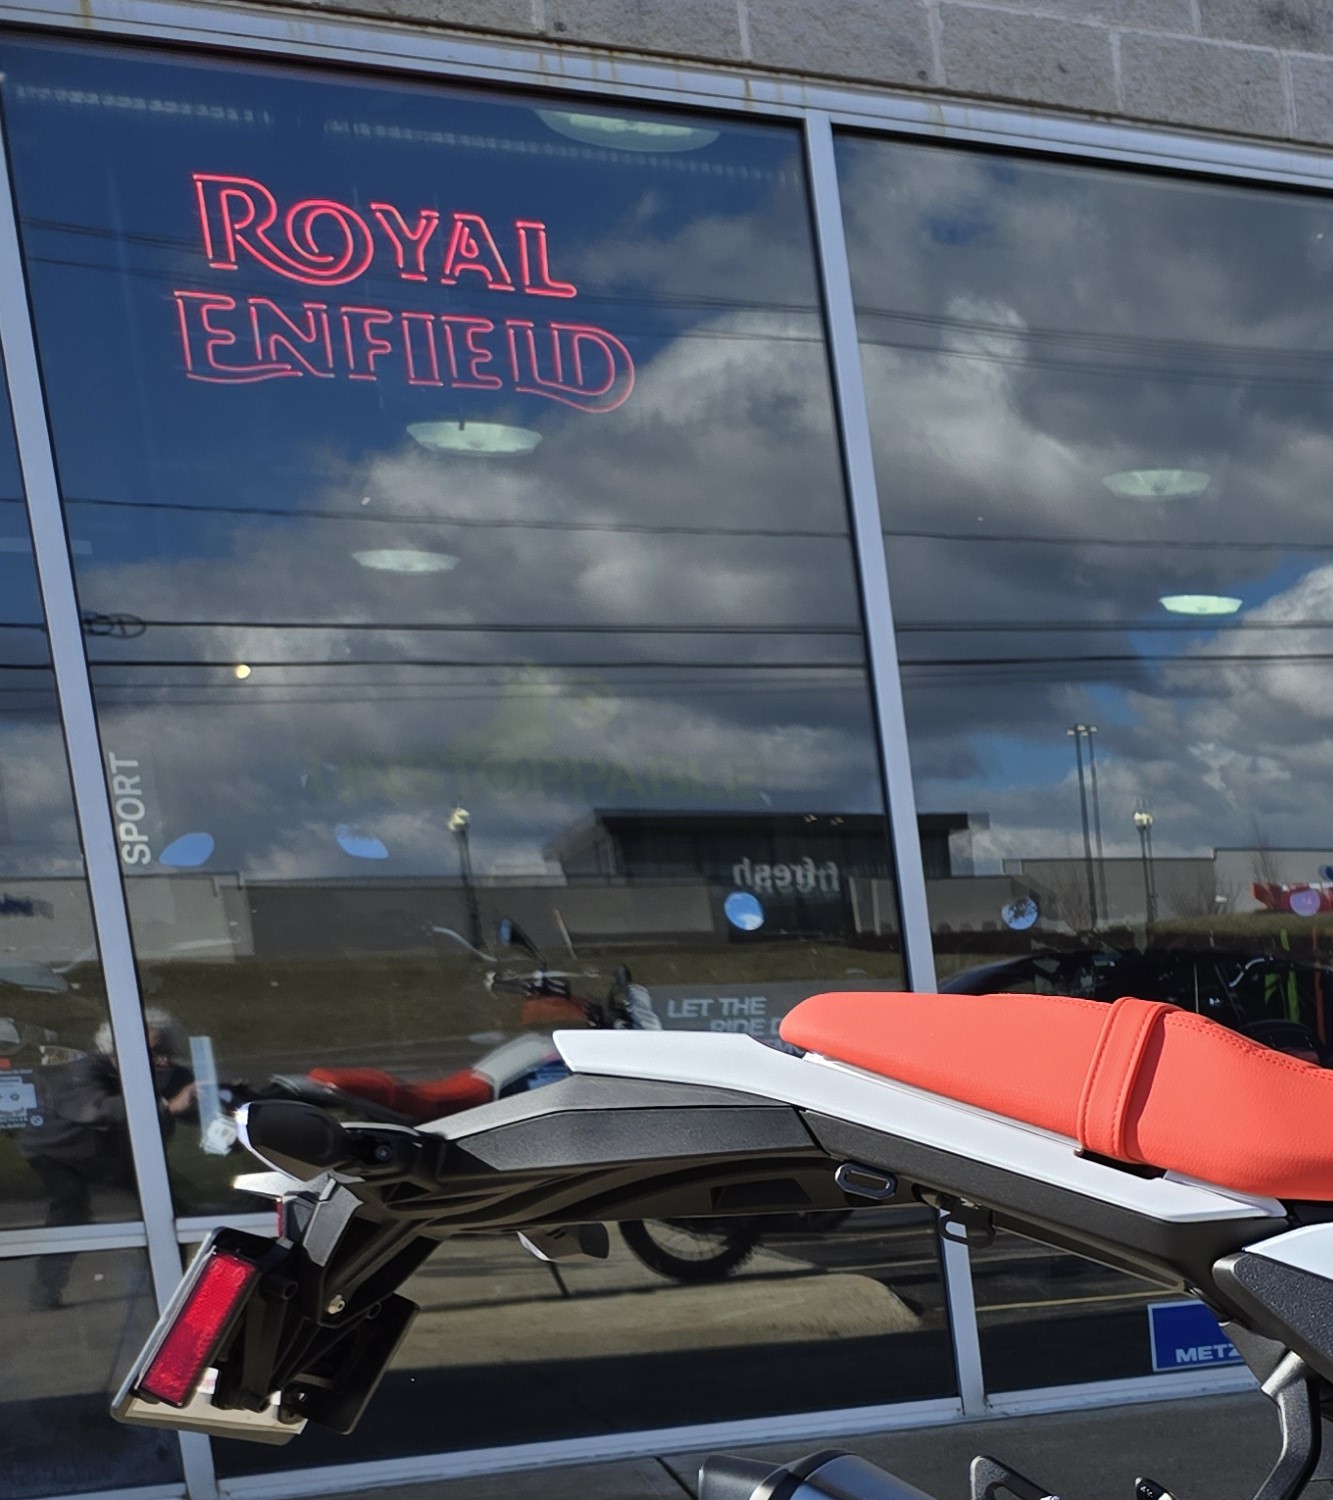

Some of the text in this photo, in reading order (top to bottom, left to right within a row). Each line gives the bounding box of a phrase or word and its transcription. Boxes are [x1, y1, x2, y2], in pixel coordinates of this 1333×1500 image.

[192, 173, 578, 299] ROYAL
[174, 290, 636, 414] ENFIELD
[109, 751, 152, 865] SPORT
[667, 996, 767, 1019] LET THE
